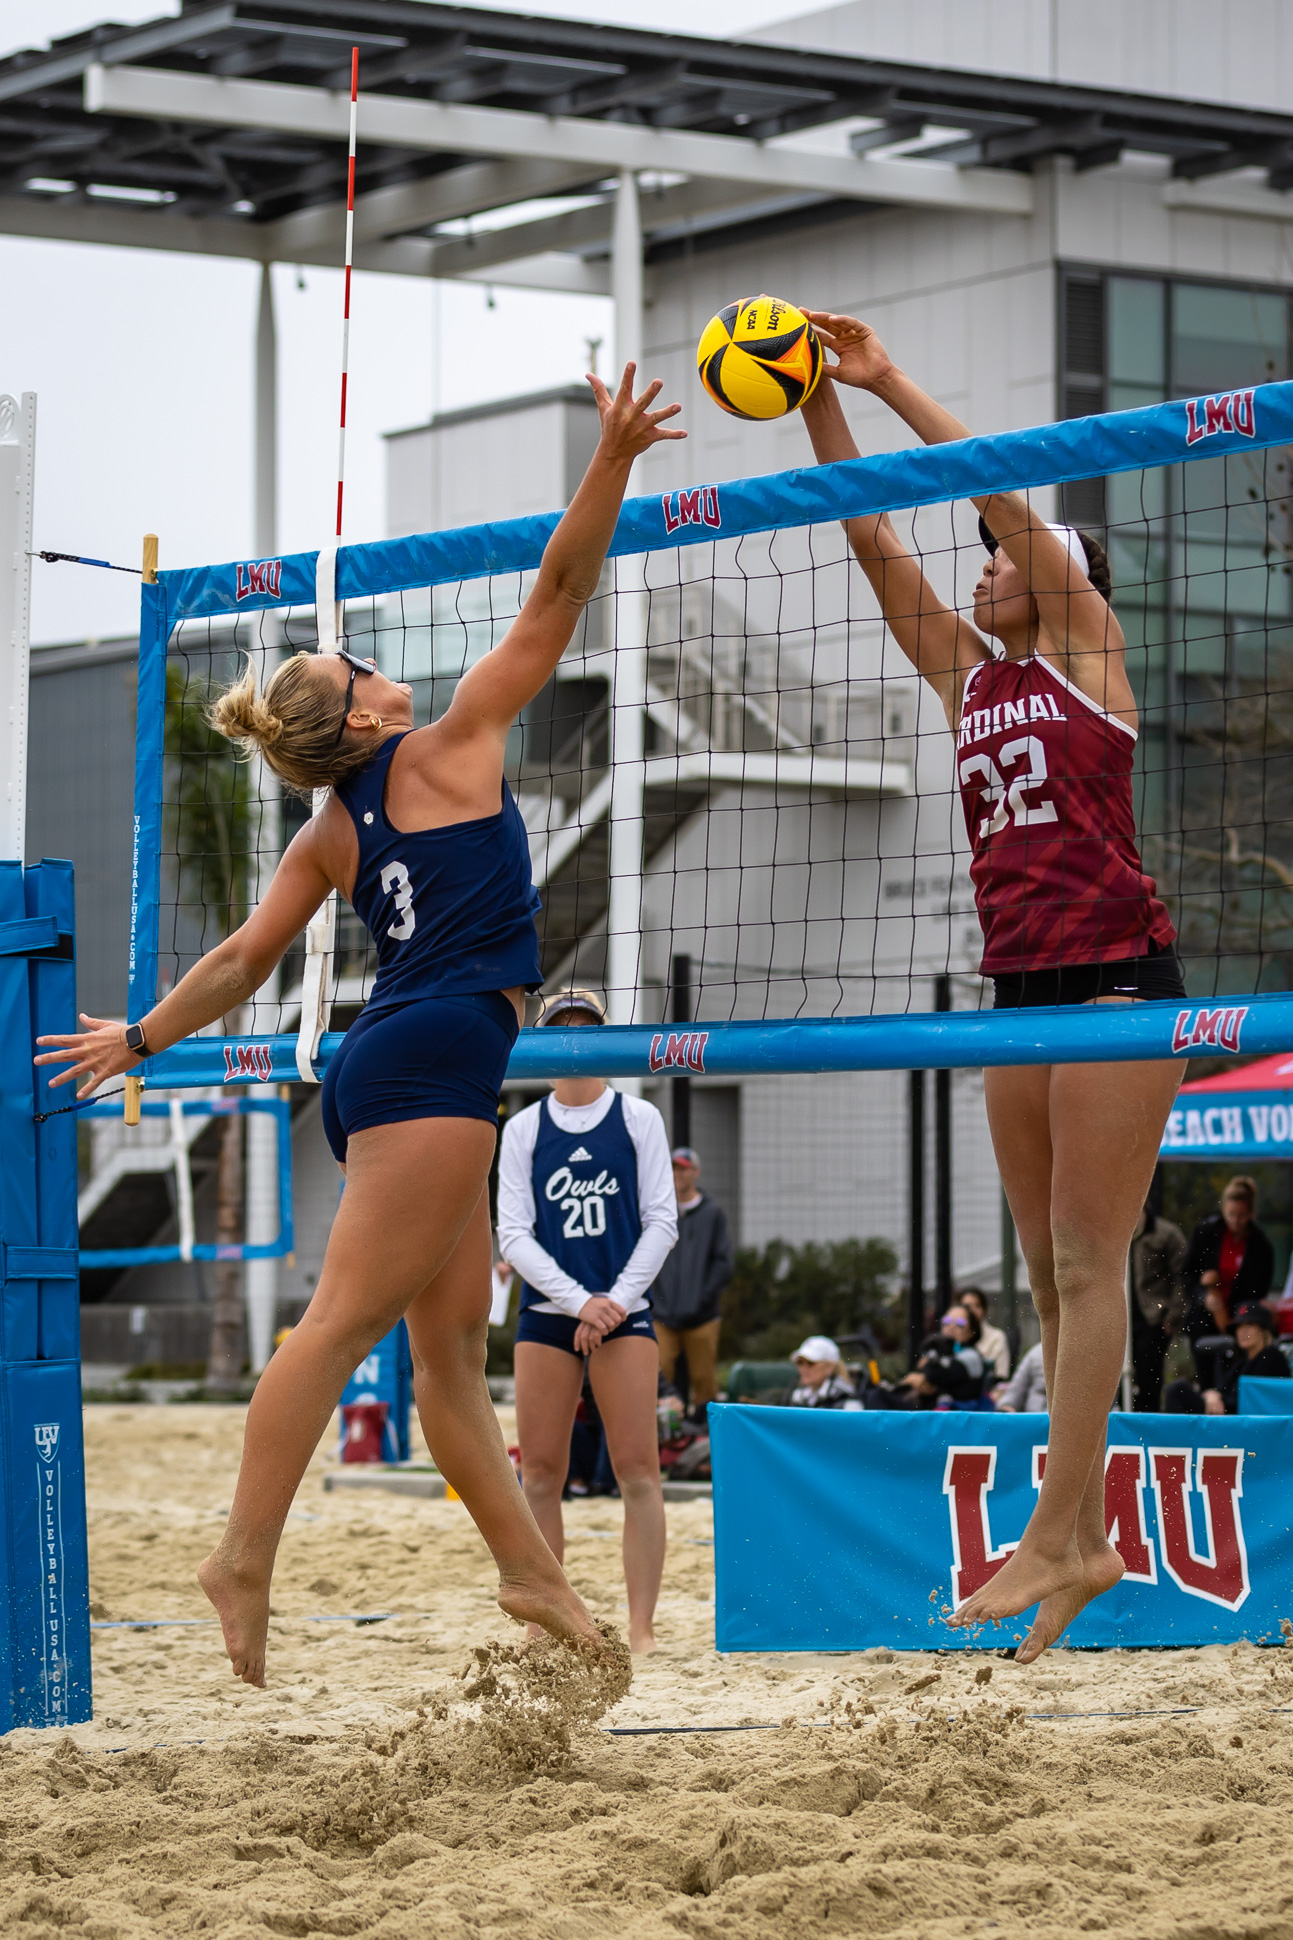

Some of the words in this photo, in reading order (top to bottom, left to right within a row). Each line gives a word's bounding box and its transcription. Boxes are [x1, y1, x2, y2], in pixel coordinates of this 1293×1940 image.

[747, 309, 758, 330] NCAA
[1185, 389, 1256, 447] LMU
[662, 484, 721, 535] LMU
[236, 559, 282, 602] LMU
[957, 693, 1068, 751] RDINAL
[959, 735, 1059, 839] 32
[380, 860, 416, 941] 3
[648, 1032, 709, 1074] LMU
[1172, 1006, 1249, 1054] LMU
[223, 1044, 273, 1083] LMU
[545, 1166, 620, 1201] Owls
[560, 1195, 606, 1239] 20
